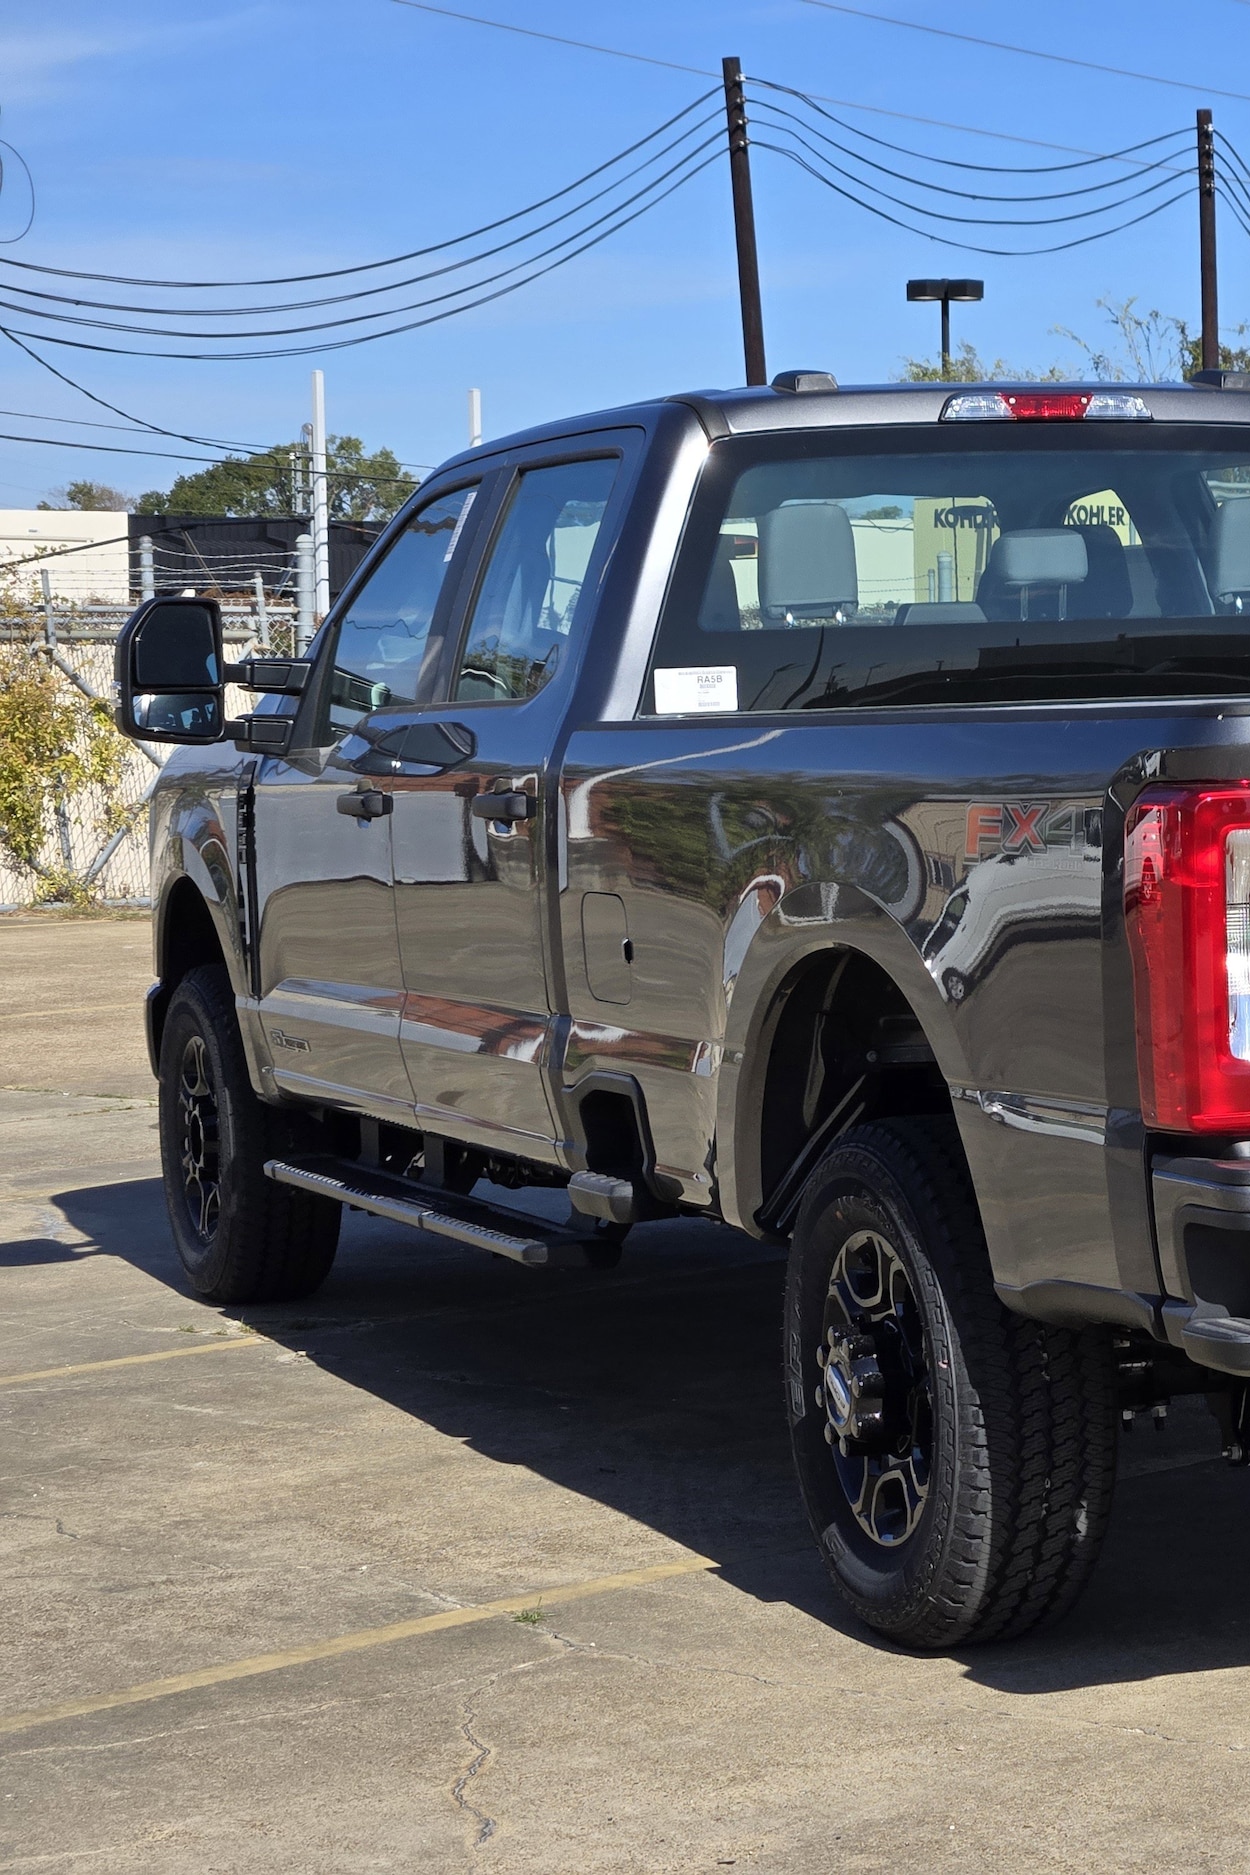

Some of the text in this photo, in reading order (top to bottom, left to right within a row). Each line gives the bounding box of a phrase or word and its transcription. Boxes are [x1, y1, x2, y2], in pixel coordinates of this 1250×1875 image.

[1066, 504, 1126, 526] KOHLER
[697, 674, 723, 684] RA5B
[963, 801, 1086, 865] FX4
